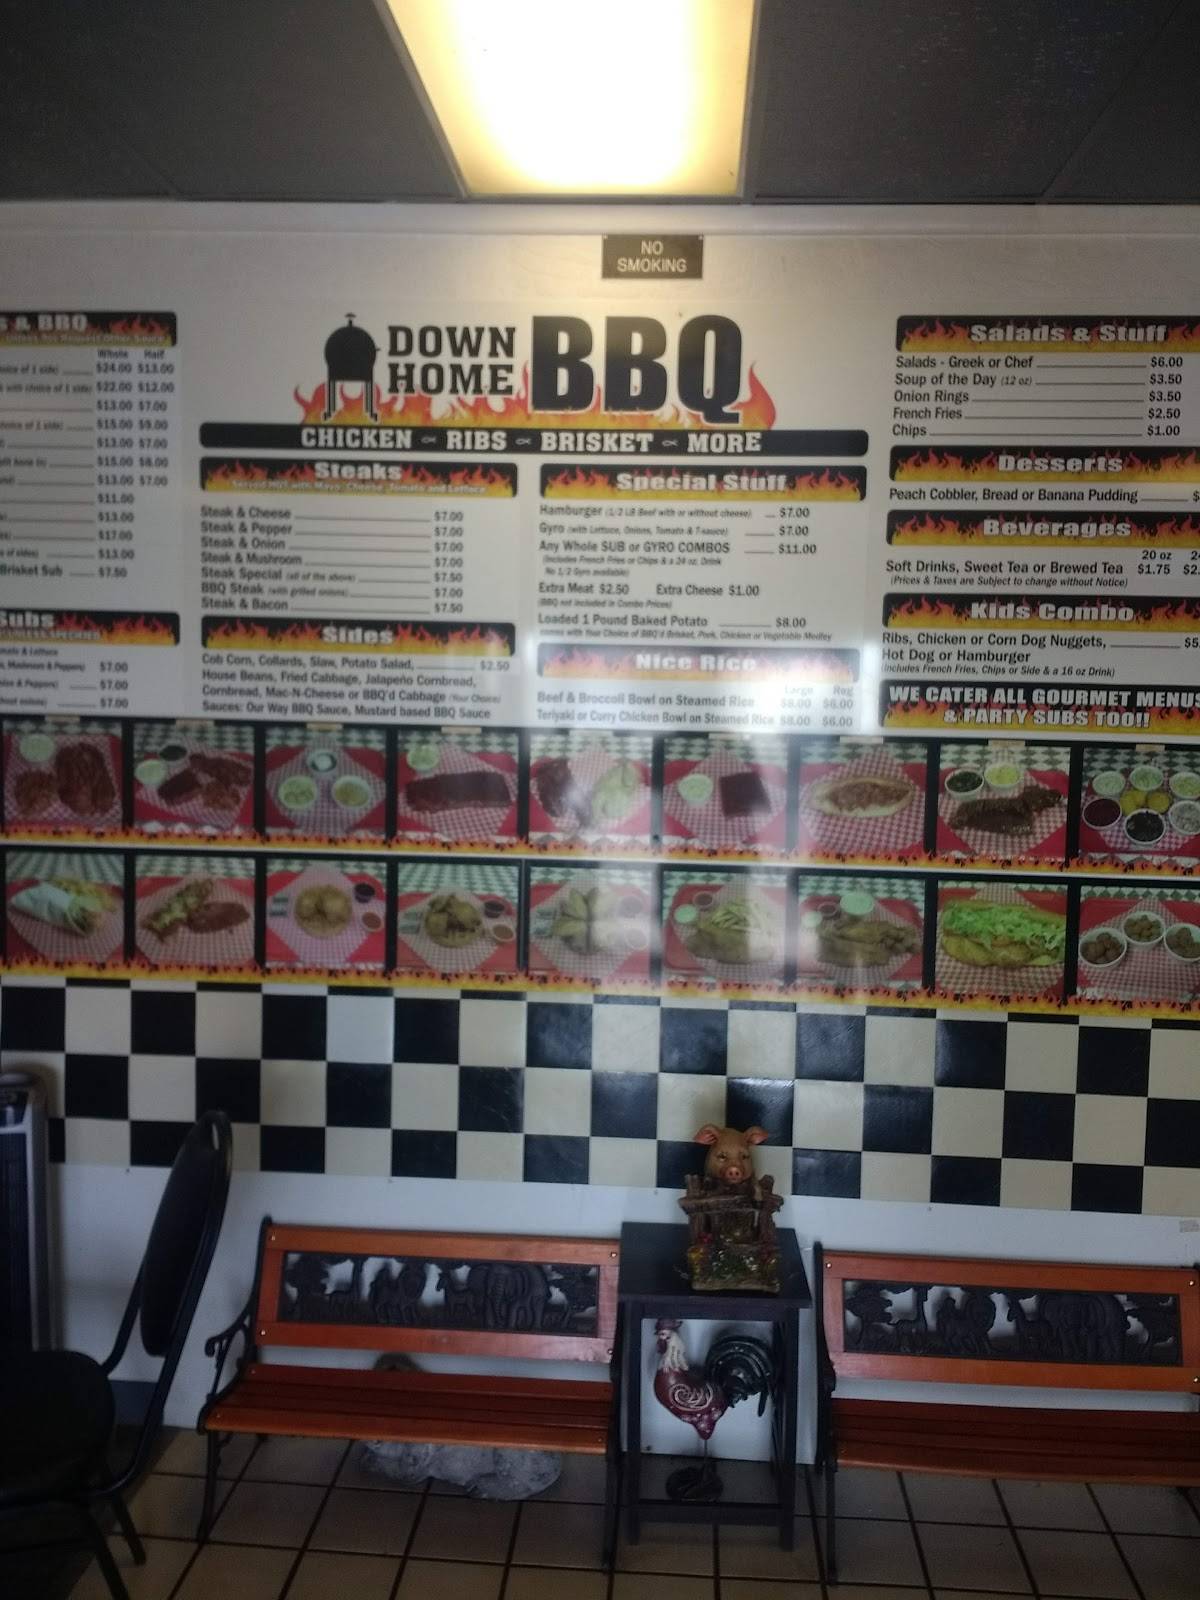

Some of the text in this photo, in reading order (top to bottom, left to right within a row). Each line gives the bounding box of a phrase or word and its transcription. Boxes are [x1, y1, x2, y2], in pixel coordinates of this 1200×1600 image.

[641, 241, 663, 255] NO
[617, 258, 687, 273] SMOKING
[970, 324, 1168, 342] Salads & Stuff
[388, 326, 516, 358] DOWN
[96, 363, 174, 374] $24.00 $13.00
[532, 315, 742, 424] BBQ
[896, 356, 1183, 369] Salads Greek or Chef $6.00
[388, 363, 514, 395] HOME
[895, 373, 1182, 388] Soup of the Day (12 oz) $3.50
[96, 382, 174, 393] $22.00 $12.00
[894, 390, 1181, 405] Onion Rings $3.50
[893, 407, 1180, 420] French Fries $2.50
[892, 424, 1180, 438] Chips $1.00
[301, 428, 762, 453] CHICKEN RIBS BRISKET MORE
[314, 462, 402, 480] Steaks
[999, 455, 1124, 473] Desserts
[616, 472, 787, 493] Special Stuff
[890, 488, 1138, 504] Peach Cobbler, Bread or Banana Pudding
[201, 506, 463, 522] Steak & Cheese $7.00
[540, 505, 809, 519] Hamburger $7.00
[201, 522, 463, 537] Steak & Pepper $7.00
[539, 523, 809, 537] Gyro $7.00
[984, 519, 1131, 538] Beverages
[539, 541, 816, 555] Any Whole SUB or GYRO COMBOS $11.00
[1142, 550, 1172, 561] 20 oz
[201, 552, 463, 568] Steak & Mushroom $7.00
[42, 565, 127, 578] Sub $7.50
[886, 561, 1170, 575] Soft Drinks, Sweet Tea or Brewed Tea $1.75
[539, 583, 629, 596] Extra Meat $2.50
[891, 576, 921, 585] (Prices
[923, 576, 930, 585] &
[933, 576, 957, 585] Taxes
[977, 576, 1010, 587] Subject
[1013, 577, 1022, 586] to
[1025, 577, 1057, 588] change
[1060, 577, 1093, 587] without
[1096, 577, 1128, 588] Notice)
[656, 584, 759, 596] Extra Cheese $1.00
[201, 598, 463, 614] Steak & Bacon $7.50
[972, 602, 1135, 621] Kids Combo
[538, 614, 806, 628] Loaded 1 Pound Baked Potato $8.00
[322, 626, 395, 646] Sides
[883, 632, 1106, 650] Ribs, Chicken or Corn Dog Nuggets,
[202, 654, 509, 671] Cob Corn, Collards, Slaw, Potato Salad, $2.50
[636, 653, 758, 672] Nice Rice
[882, 649, 1031, 665] Hot Dog or Hamburger
[923, 665, 952, 674] French
[955, 665, 978, 675] Fries,
[981, 665, 1006, 677] Chips
[1021, 666, 1040, 676] Side
[1043, 666, 1050, 676] &
[1062, 667, 1073, 676] 16
[1076, 669, 1086, 677] oz
[1089, 667, 1115, 678] Drink)
[890, 686, 1200, 708] WE CATER ALL GOURMET MENUS
[944, 709, 1150, 728] & PARTY SUBS TOO!!
